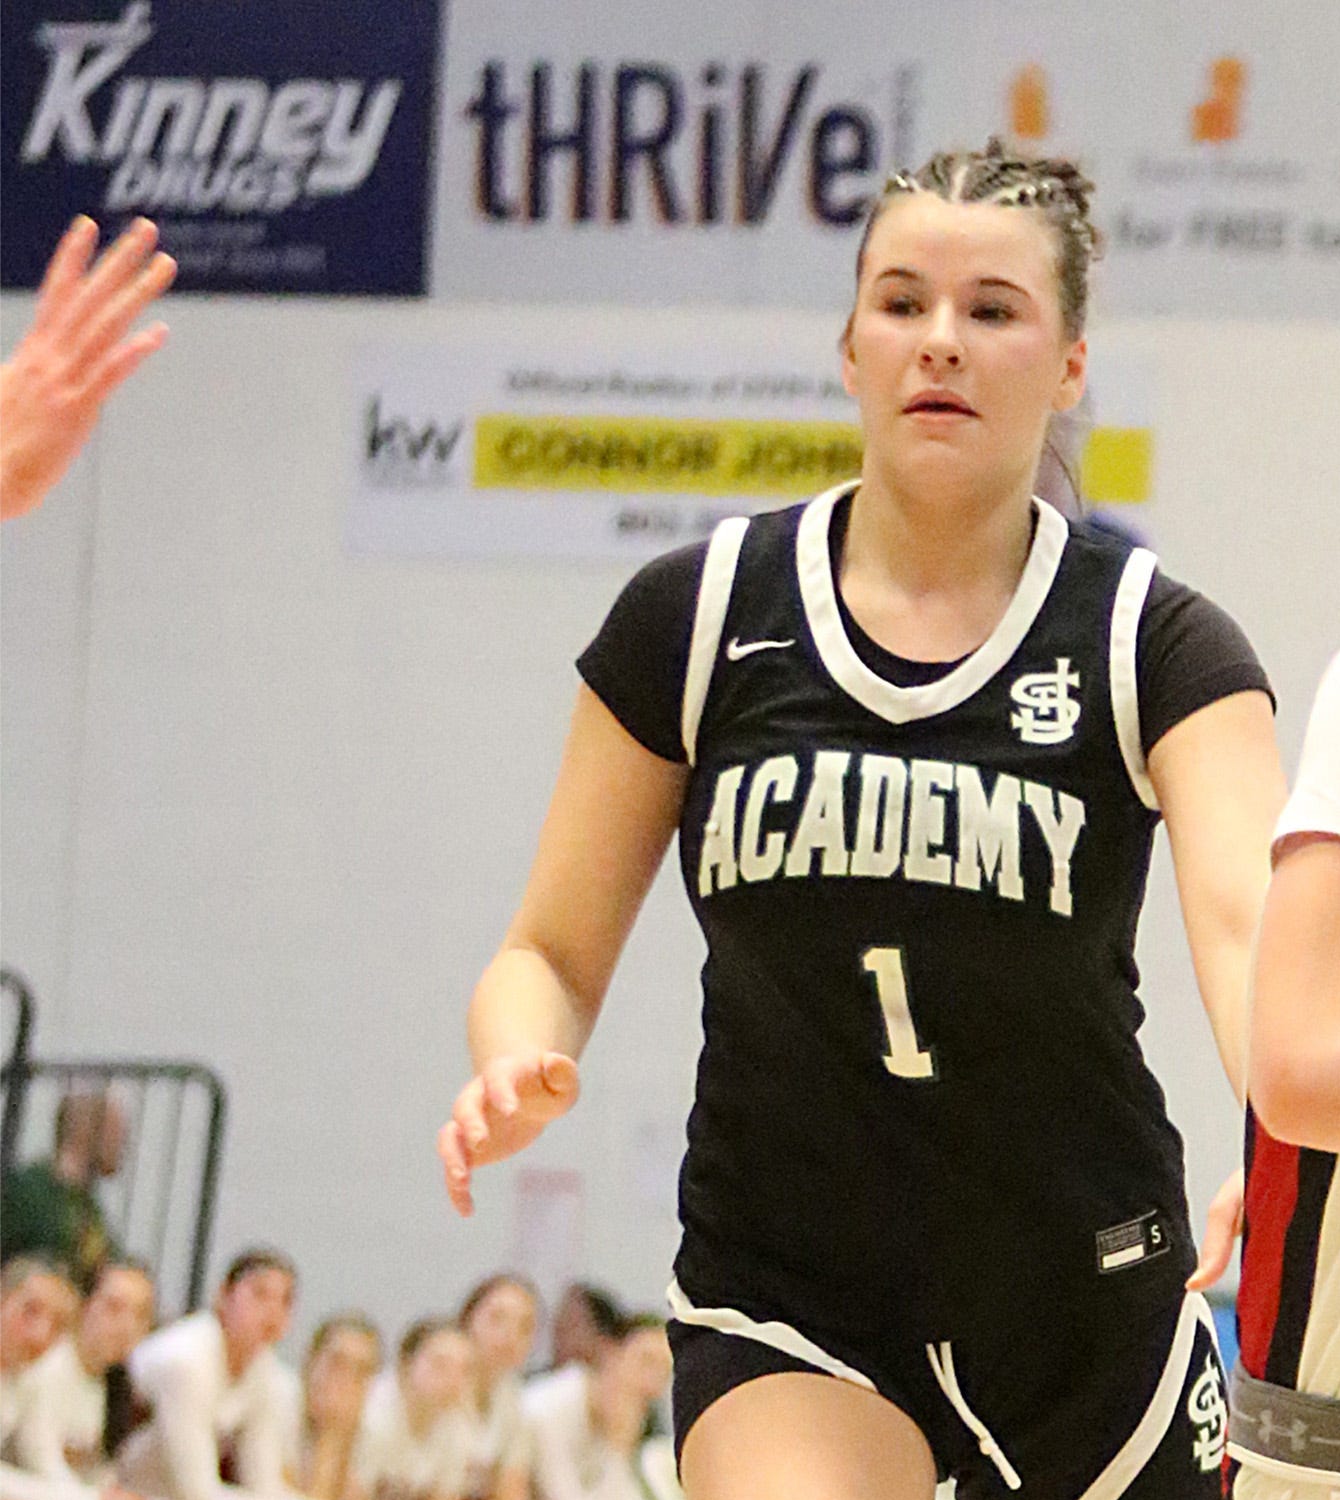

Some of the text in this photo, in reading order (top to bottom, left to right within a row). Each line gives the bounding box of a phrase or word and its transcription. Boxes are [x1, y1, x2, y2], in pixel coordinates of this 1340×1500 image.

[20, 2, 402, 197] Kinney
[466, 58, 878, 228] tHRiVe
[497, 424, 718, 472] CONNOR
[700, 751, 1085, 917] ACADEMY
[863, 946, 934, 1078] 1
[1151, 1226, 1161, 1244] S
